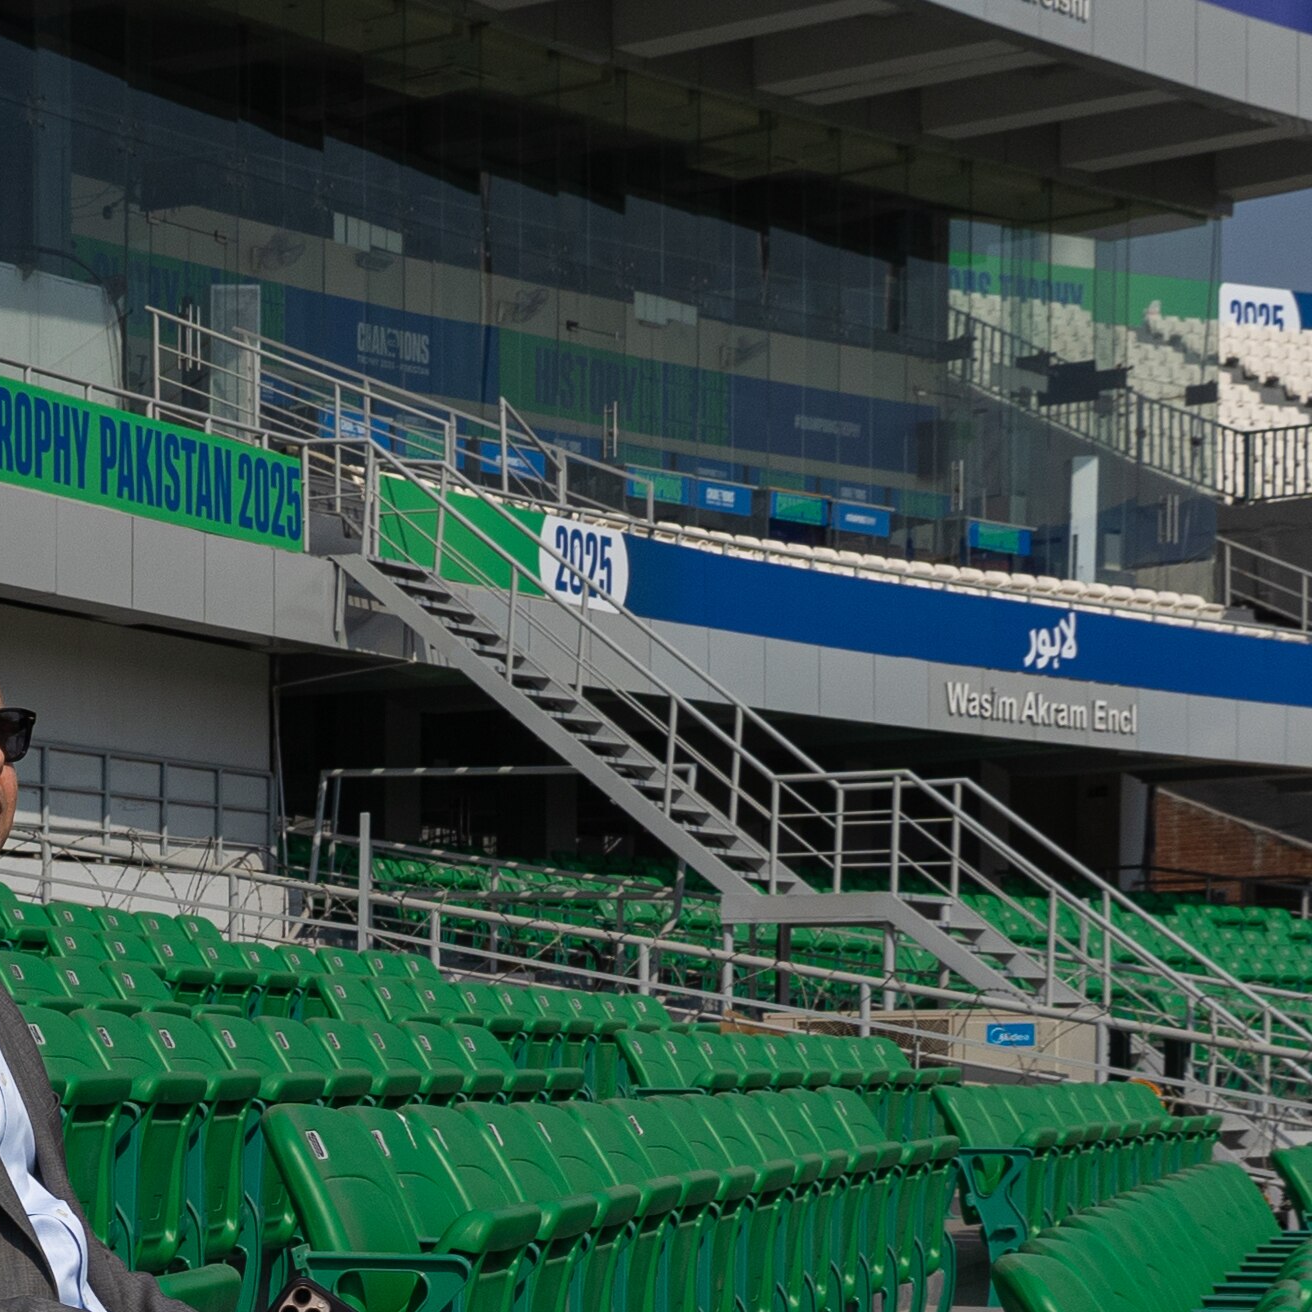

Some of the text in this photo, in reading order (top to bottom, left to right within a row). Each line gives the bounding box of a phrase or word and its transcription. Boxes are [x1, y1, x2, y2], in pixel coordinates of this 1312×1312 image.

[1229, 299, 1285, 332] 2025
[98, 413, 233, 526] PAKISTAN
[237, 452, 303, 542] 2025
[554, 524, 613, 601] 2025
[1023, 611, 1078, 669] لاہور
[946, 681, 1138, 734] Wasim Akram Encl
